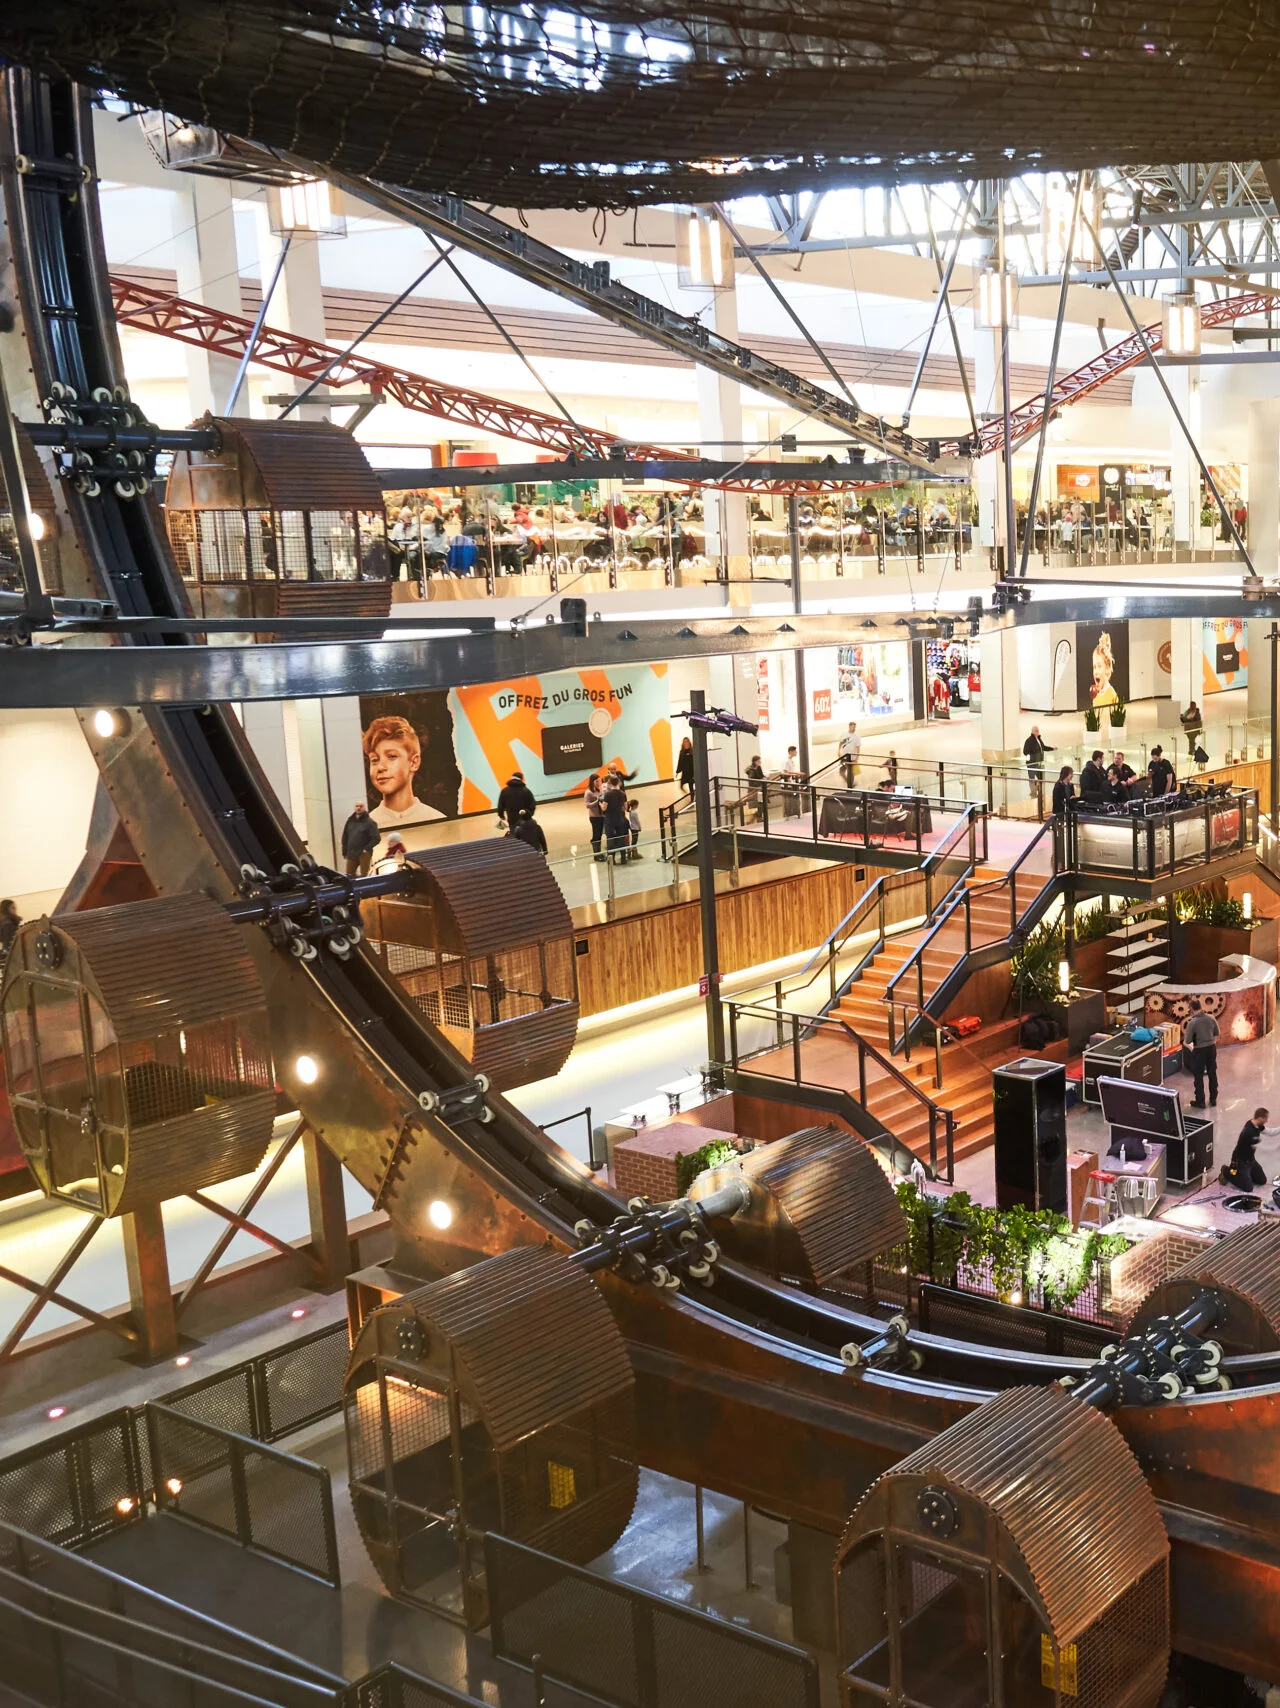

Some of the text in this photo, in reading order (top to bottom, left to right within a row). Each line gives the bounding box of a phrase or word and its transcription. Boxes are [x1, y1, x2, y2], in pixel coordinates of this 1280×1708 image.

[498, 683, 633, 710] OFFREZ DU GROS FUN
[814, 697, 831, 713] 60%
[560, 742, 585, 751] GALERIES
